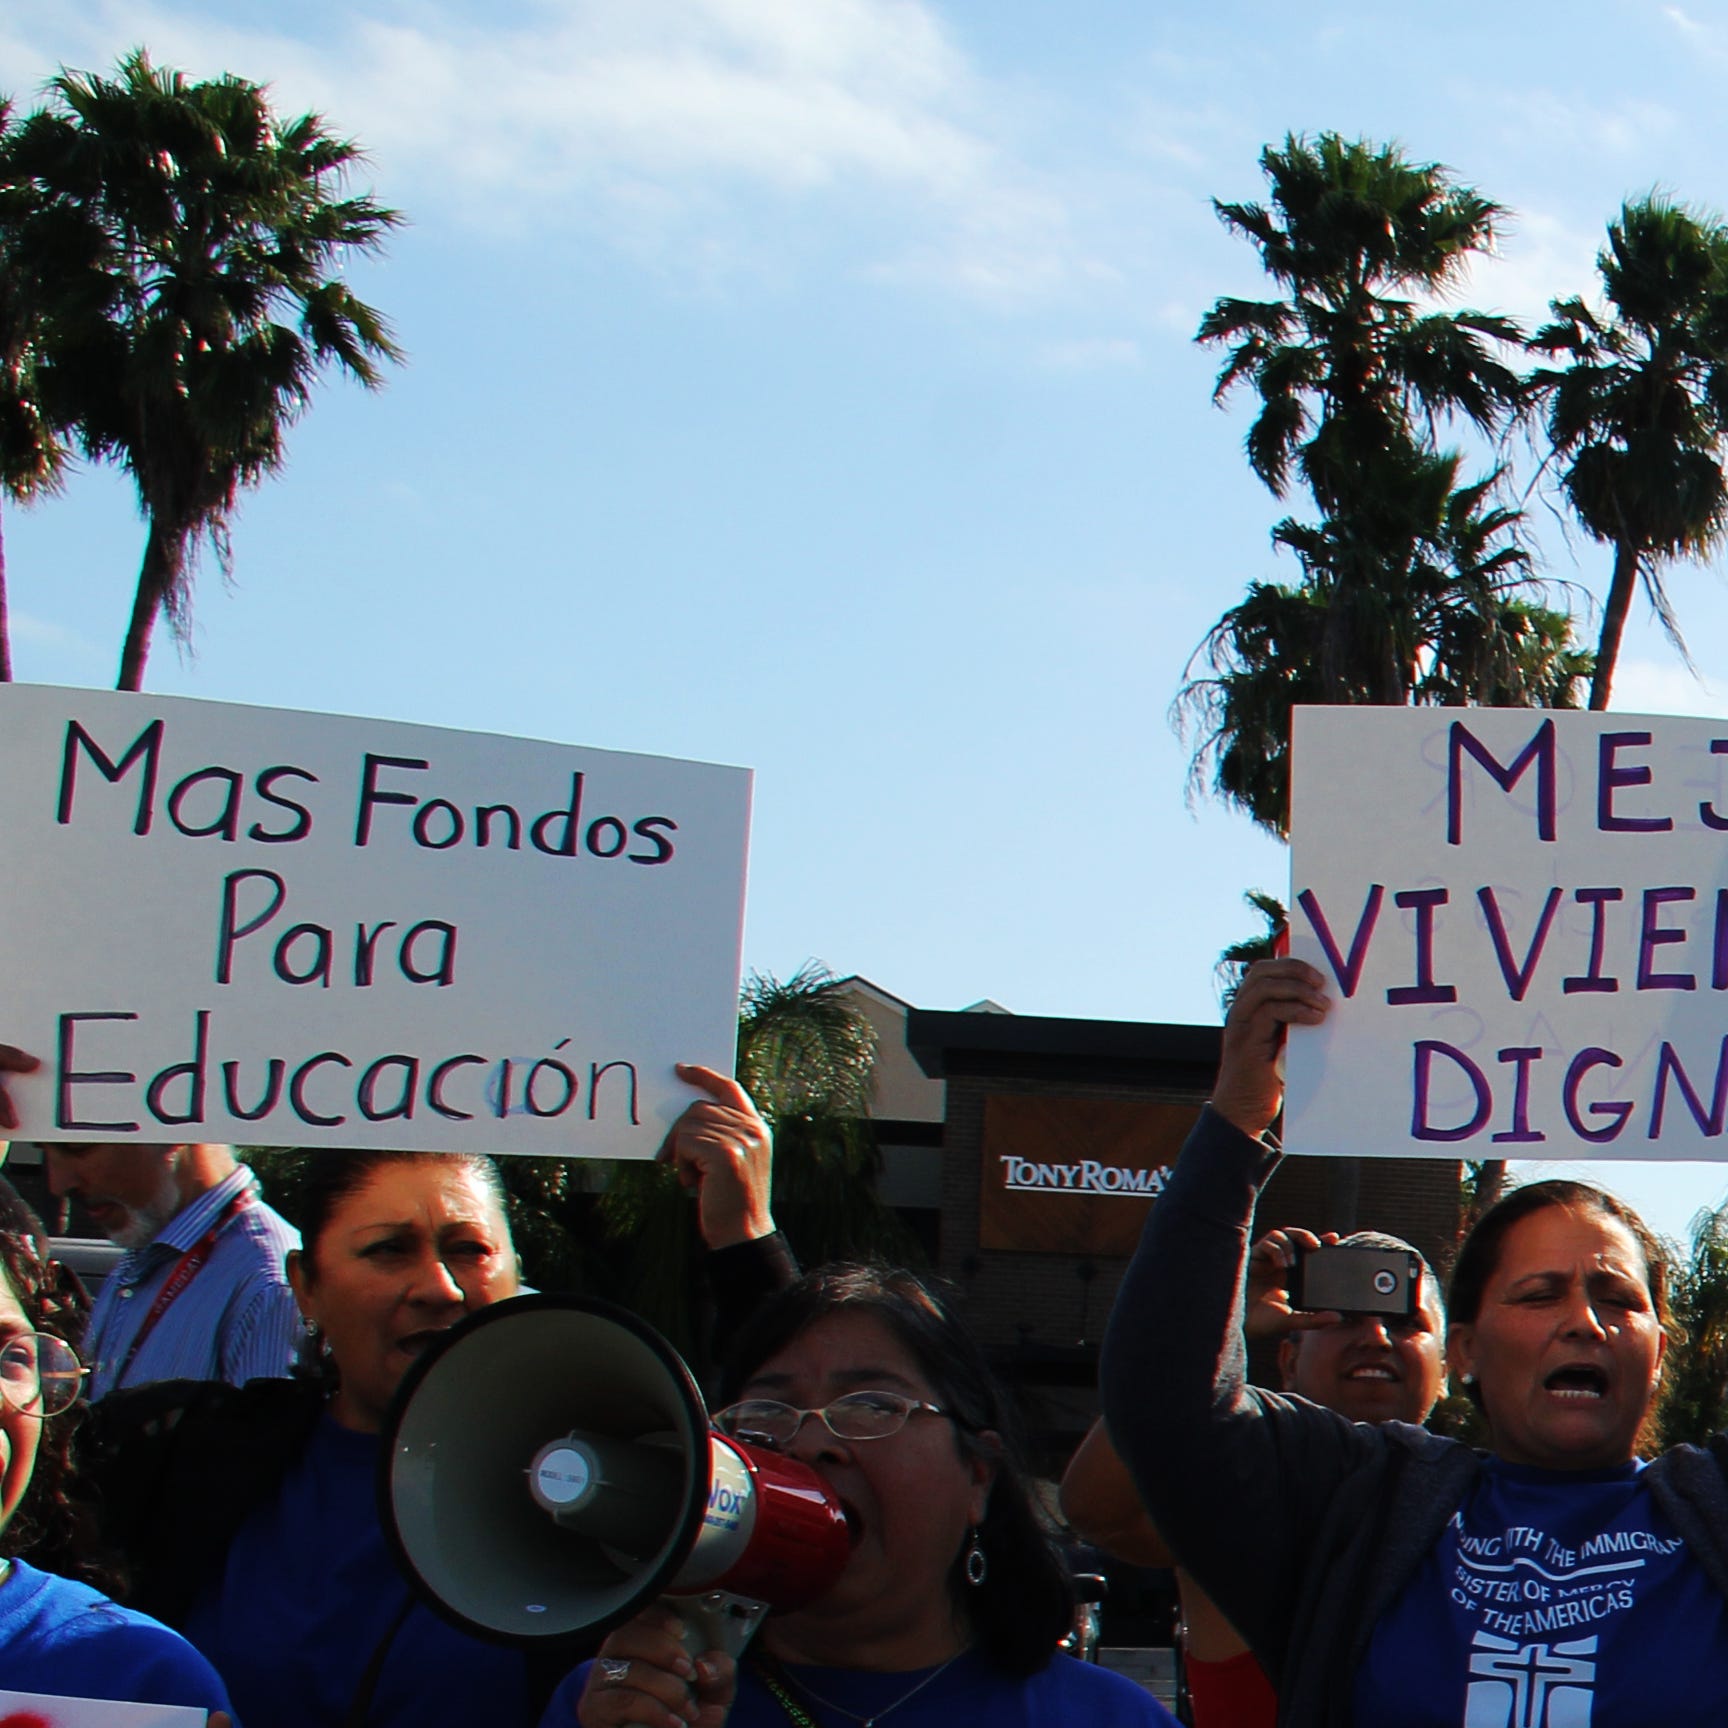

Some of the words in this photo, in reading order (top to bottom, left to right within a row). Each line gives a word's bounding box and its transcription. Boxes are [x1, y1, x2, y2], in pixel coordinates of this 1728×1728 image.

[57, 718, 320, 843] Mas
[354, 752, 679, 865] Fondos
[215, 867, 458, 988] Para
[56, 1008, 641, 1132] Educación
[1451, 1587, 1478, 1611] OF
[1483, 1607, 1524, 1636] THE
[1524, 1589, 1634, 1634] AMERICAS
[1523, 1579, 1551, 1602] OF
